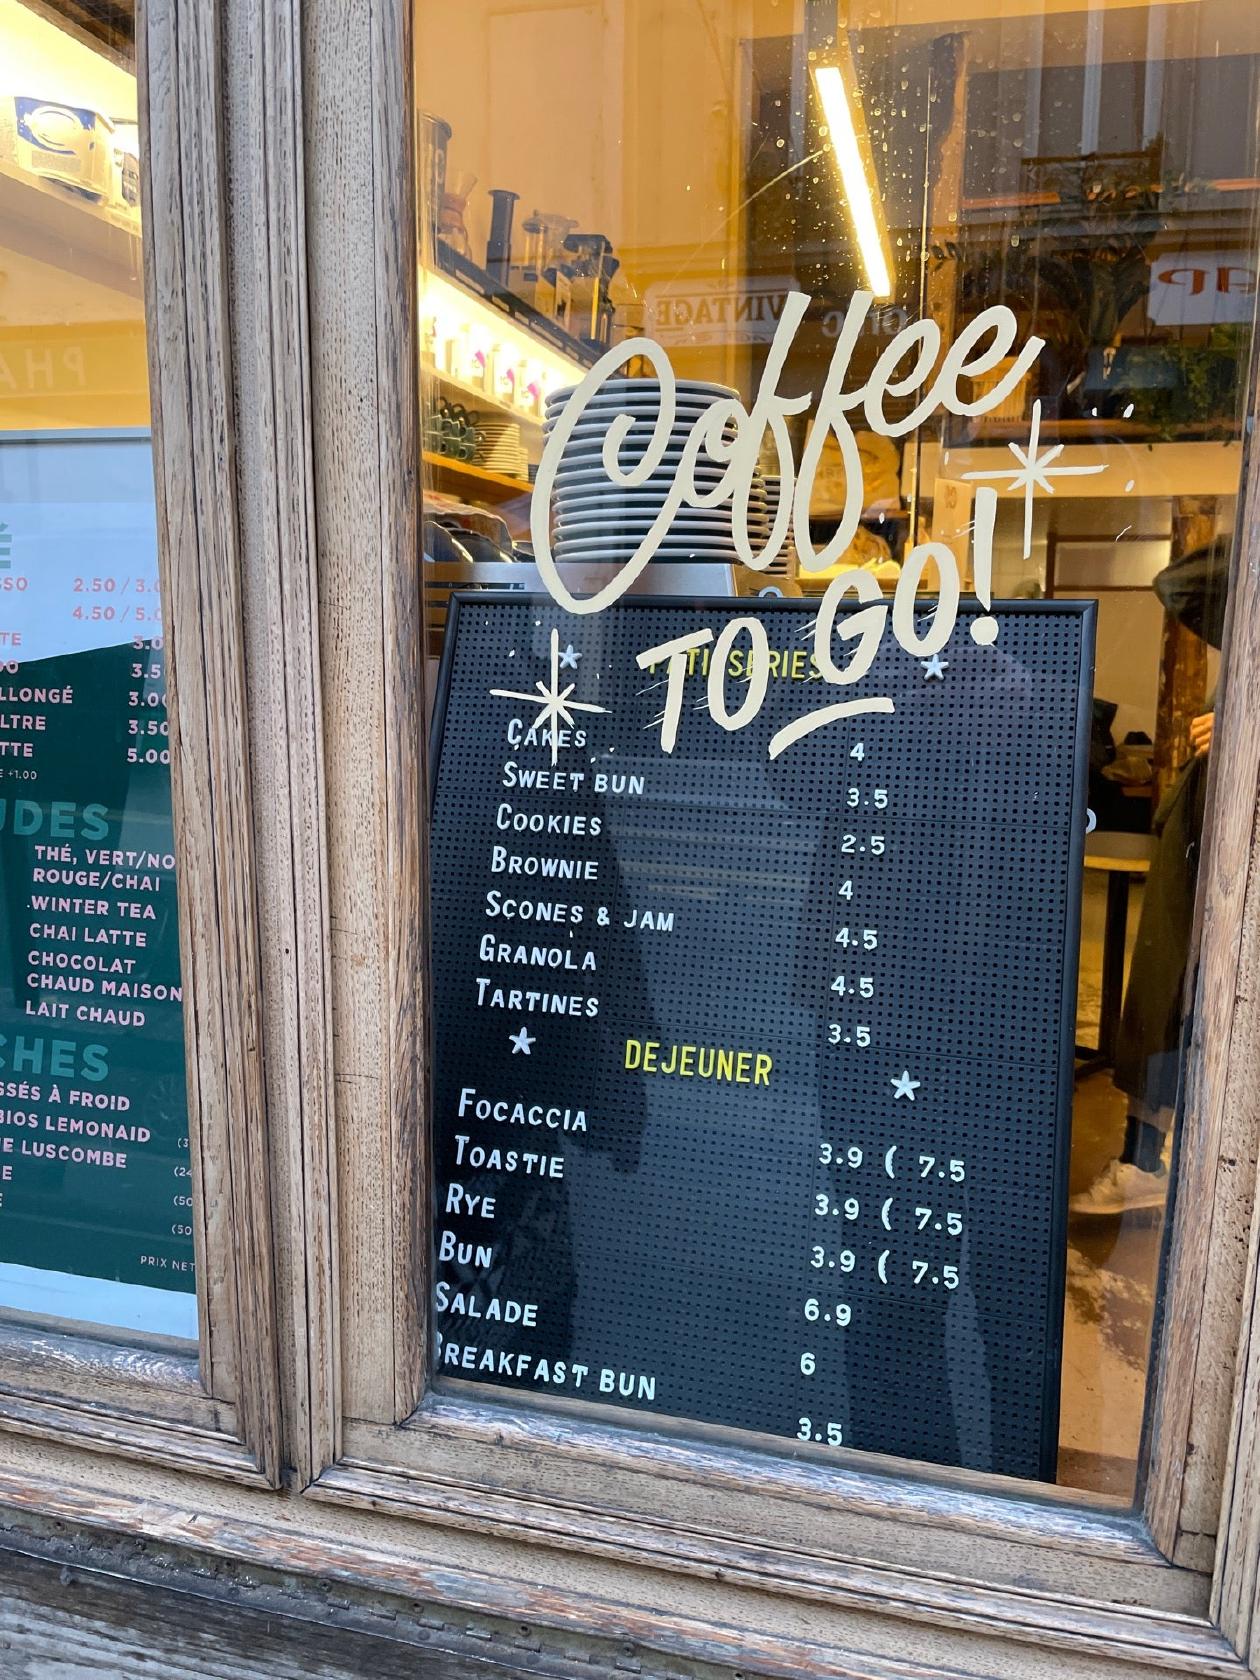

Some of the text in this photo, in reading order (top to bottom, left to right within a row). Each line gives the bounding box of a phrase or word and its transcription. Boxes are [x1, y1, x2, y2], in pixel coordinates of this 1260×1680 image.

[530, 290, 1046, 615] Coffee
[0, 576, 28, 592] SO
[73, 578, 116, 592] 2.50
[73, 606, 115, 620] 4.50
[636, 486, 998, 753] TO GO!
[133, 636, 163, 650] 3.0
[131, 664, 165, 679] 3.5
[0, 685, 73, 704] LLONGÉ
[0, 714, 169, 735] LTRE 3.50
[508, 718, 587, 748] CAKES
[0, 741, 170, 763] TTE 5.00
[850, 742, 865, 761] 4
[502, 761, 646, 795] SWEET BUN
[846, 787, 889, 809] 3.5
[0, 799, 109, 841] DES
[496, 803, 602, 836] COOKIES
[34, 844, 176, 870] THÉ, VERT/NO
[841, 834, 886, 856] 2.5
[491, 845, 599, 880] BROWNIE
[32, 867, 161, 892] ROUGE/CHAI
[838, 880, 853, 900] 4
[31, 895, 157, 920] WINTER TEA
[485, 889, 675, 932] SCONES & JAM
[29, 922, 147, 948] CHAI LATTE
[835, 927, 878, 950] 4.5
[27, 950, 136, 975] CHOCOLAT
[479, 933, 597, 971] GRANOLA
[26, 972, 183, 1002] CHAUD MAISON
[475, 977, 599, 1018] TARTINES
[831, 975, 874, 999] 4.5
[25, 1000, 146, 1027] LAIT CHAUD
[828, 1023, 871, 1048] 3.5
[0, 1033, 109, 1082] HES
[624, 1039, 773, 1086] DEJEUNER
[48, 1083, 61, 1104] À
[69, 1090, 130, 1112] FROID
[457, 1087, 588, 1132] FOCACCIA
[45, 1115, 151, 1143] LEMONAID
[21, 1140, 127, 1169] LUSCOMBE
[454, 1134, 565, 1179] TOASTIE
[818, 1142, 863, 1169] 3.9
[918, 1154, 966, 1182] 7.5
[445, 1182, 496, 1220] RYE
[814, 1193, 860, 1221] 3.9
[914, 1207, 963, 1236] 7.5
[171, 1225, 193, 1236] (50
[140, 1255, 167, 1269] PRIX
[438, 1230, 493, 1268] BUN
[810, 1245, 856, 1273] 3.9
[911, 1260, 960, 1290] 7.5
[435, 1281, 539, 1328] SALADE
[804, 1297, 852, 1327] 6.9
[800, 1352, 816, 1376] 6
[599, 1367, 657, 1401] BUN
[797, 1417, 843, 1447] 3.5
